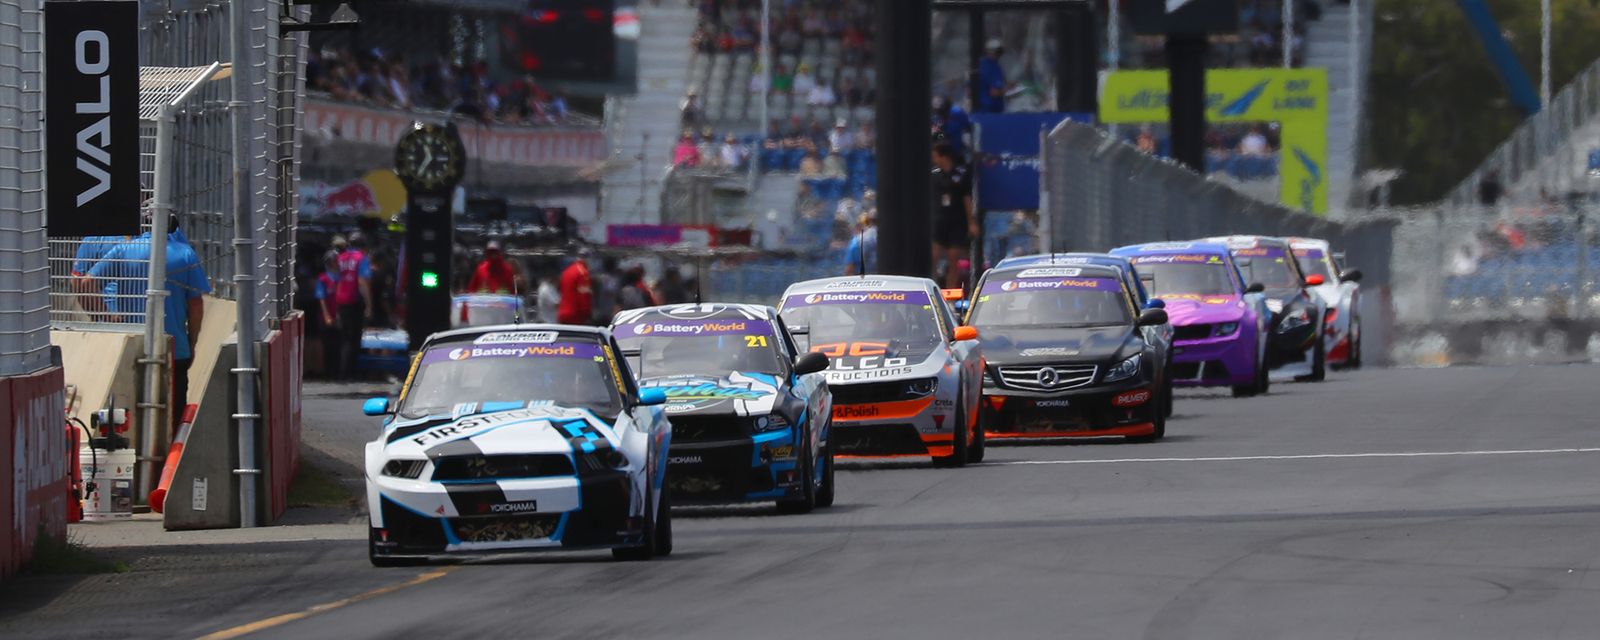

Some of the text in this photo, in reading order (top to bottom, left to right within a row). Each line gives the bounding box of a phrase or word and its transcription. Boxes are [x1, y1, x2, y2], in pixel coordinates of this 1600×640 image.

[75, 29, 112, 207] VALO
[654, 323, 746, 334] BatteryWorld
[744, 335, 767, 348] 21
[472, 346, 574, 358] BatteryWorld
[822, 366, 912, 381] TRUCTIONS
[668, 456, 702, 464] OKOHAMA
[490, 502, 535, 512] YOKOHAMA
